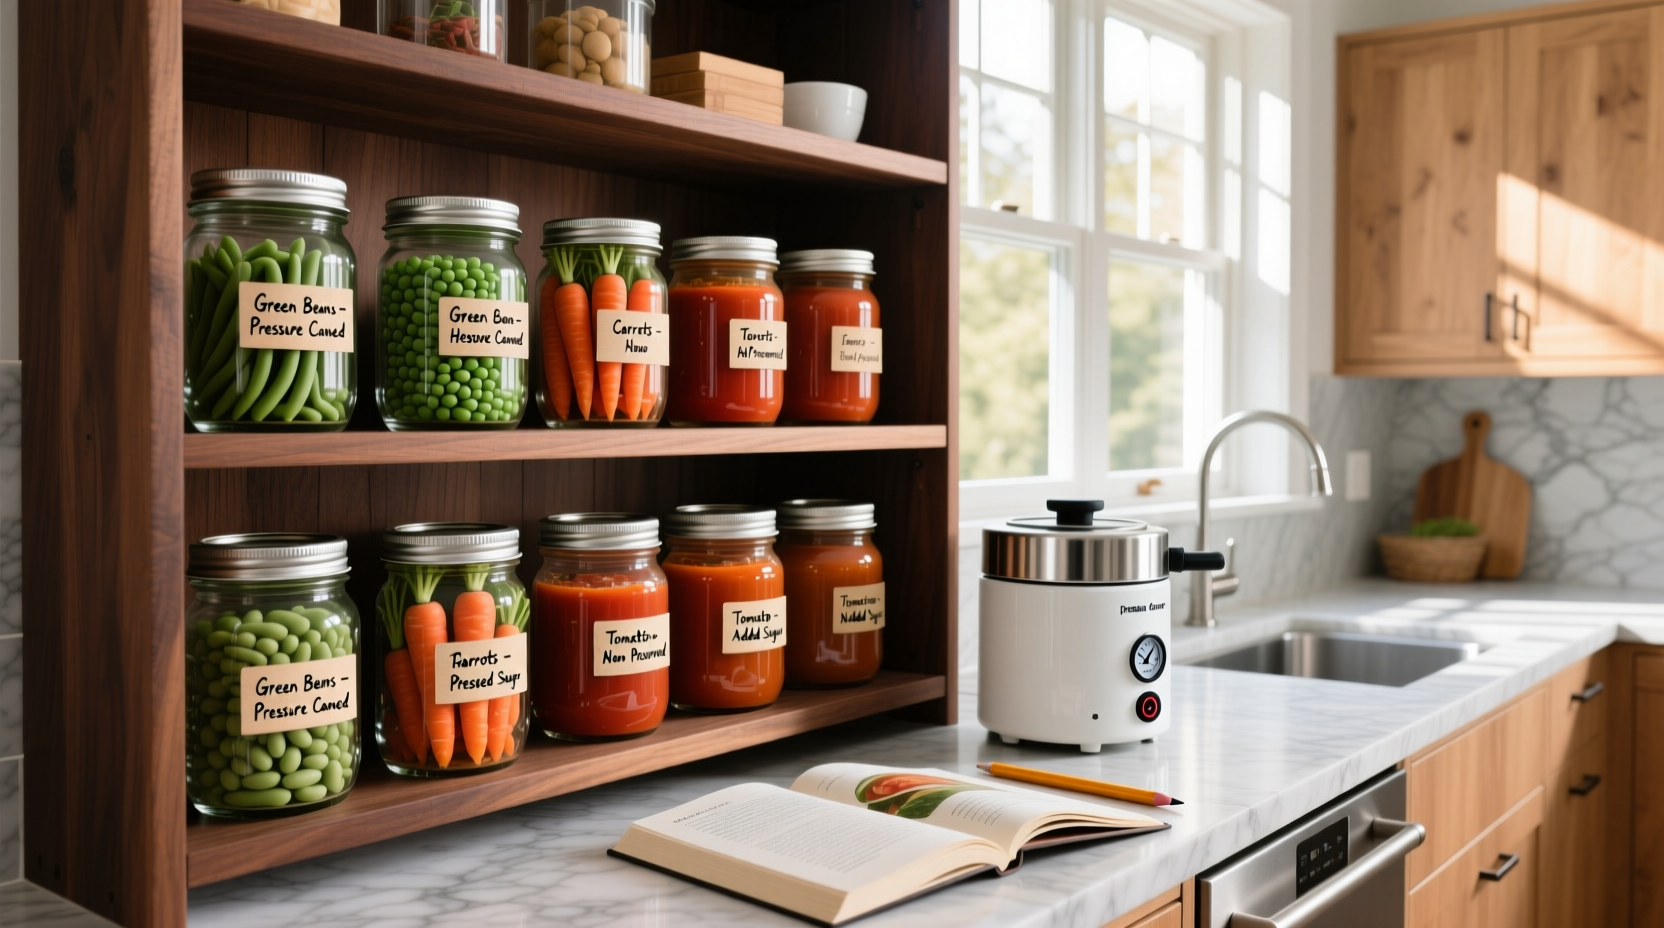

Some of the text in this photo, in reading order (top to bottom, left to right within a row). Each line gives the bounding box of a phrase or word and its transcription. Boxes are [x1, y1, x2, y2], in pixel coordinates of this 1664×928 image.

[254, 292, 297, 313] Green
[303, 296, 337, 315] Beans
[449, 305, 488, 323] Green
[250, 316, 304, 336] Pressure
[255, 676, 298, 697] Green
[254, 701, 308, 722] Pressure
